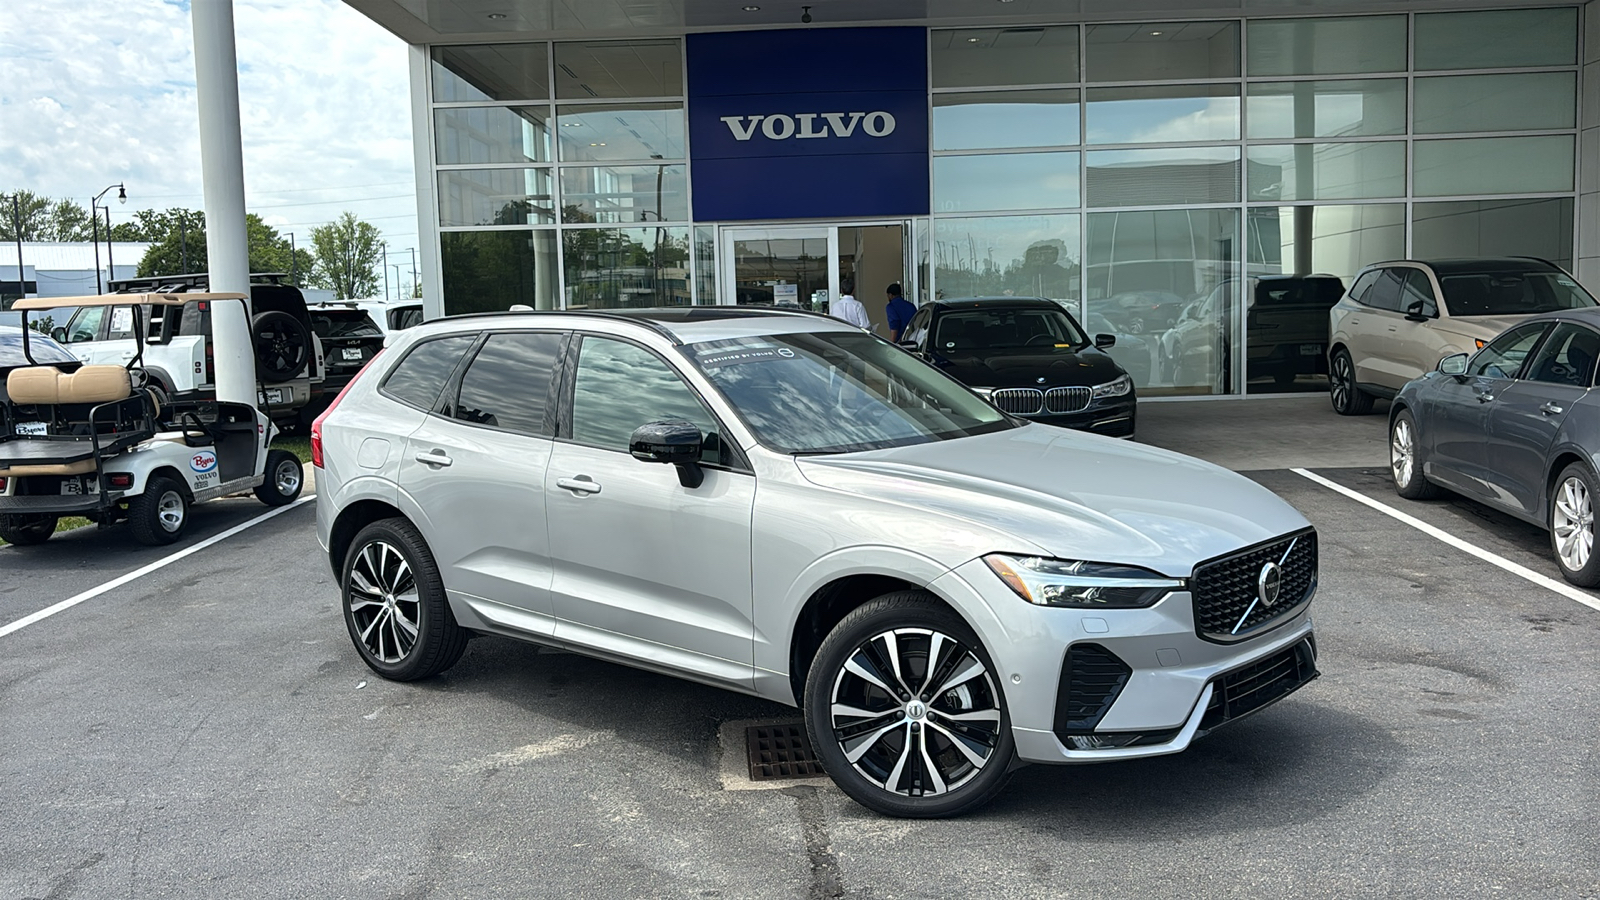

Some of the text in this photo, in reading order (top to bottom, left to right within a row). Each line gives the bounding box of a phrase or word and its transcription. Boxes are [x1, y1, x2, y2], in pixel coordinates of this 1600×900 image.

[720, 111, 896, 141] VOLVO
[704, 354, 740, 364] CERTIFIED
[193, 455, 215, 468] Byers
[195, 471, 217, 481] VOLVO
